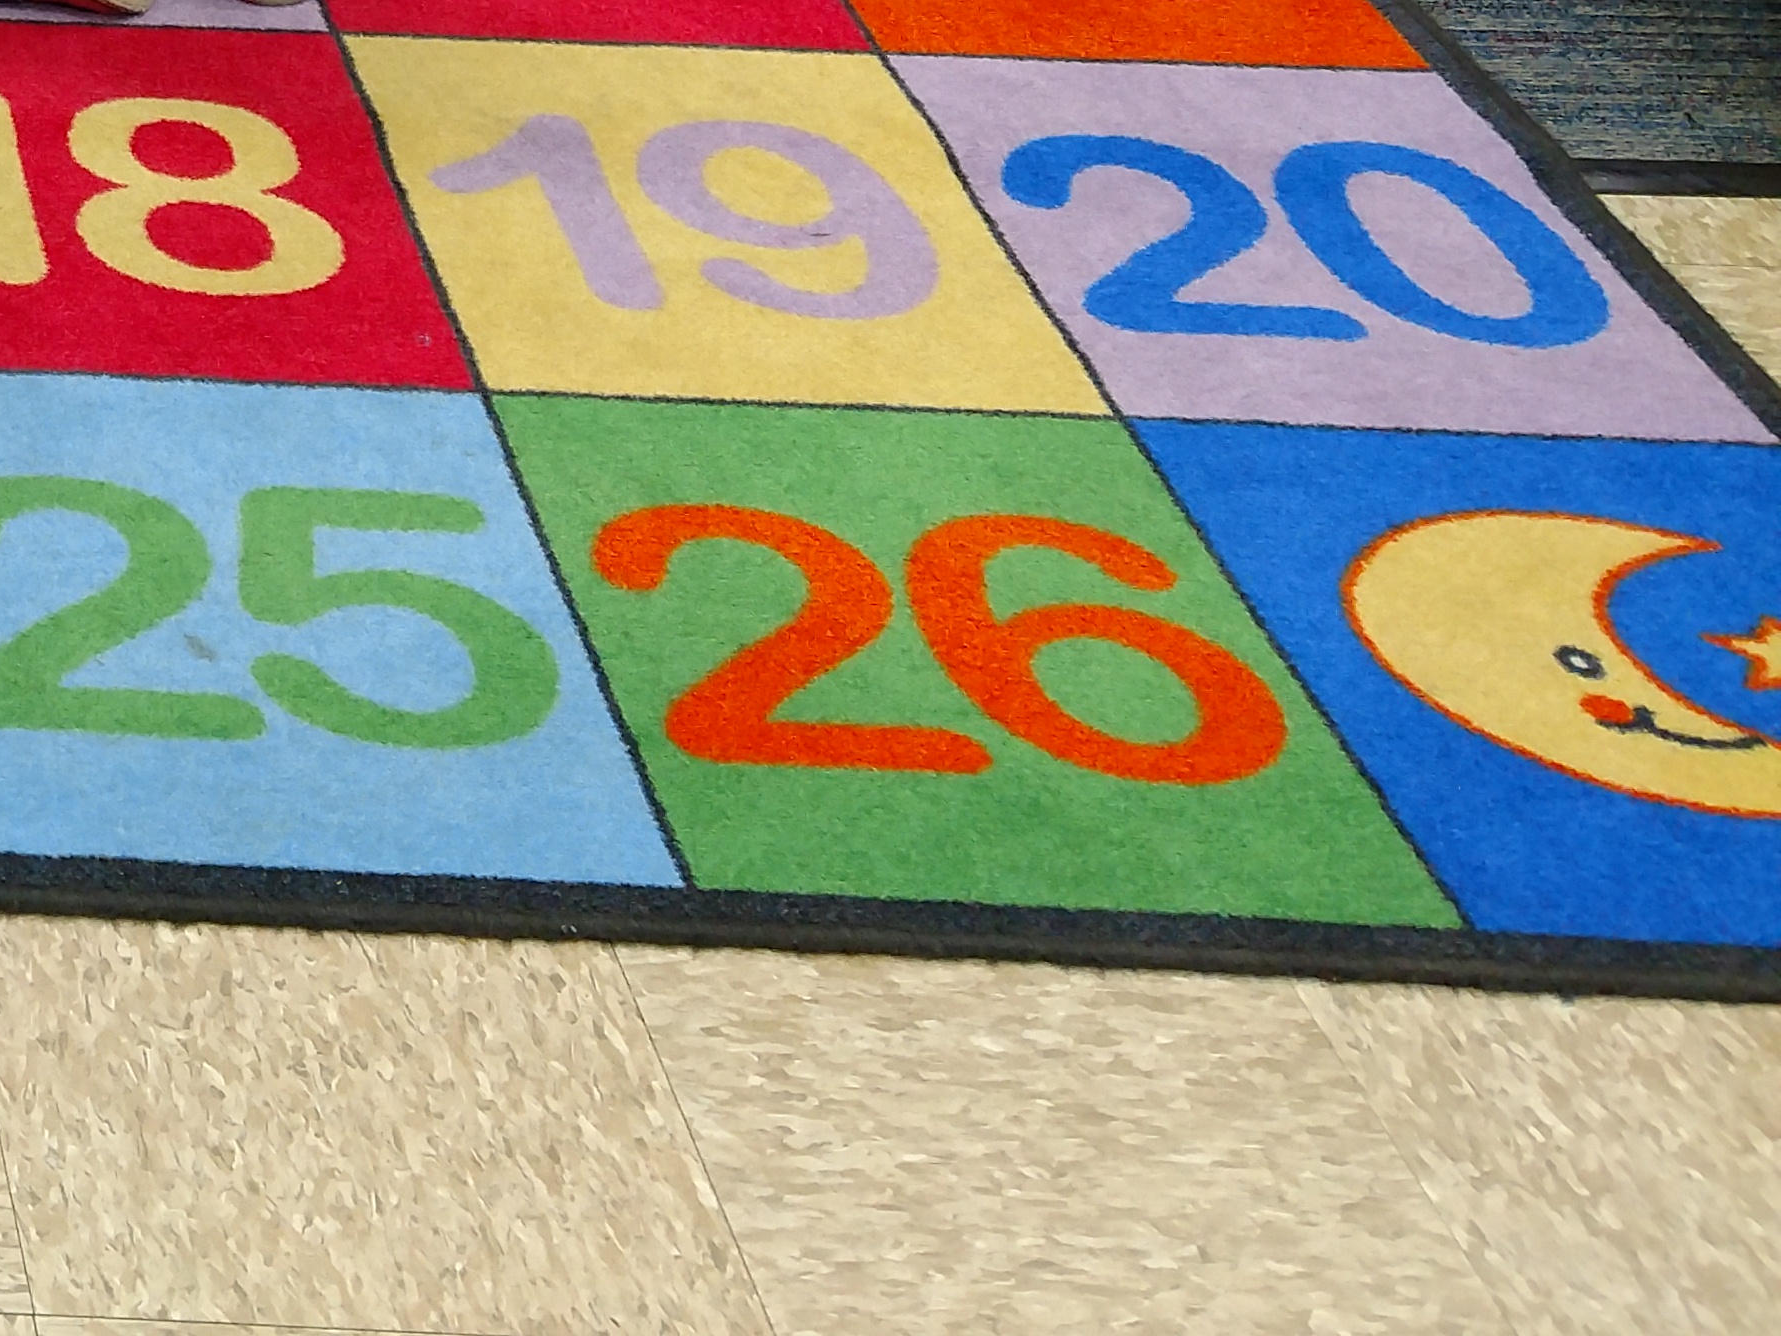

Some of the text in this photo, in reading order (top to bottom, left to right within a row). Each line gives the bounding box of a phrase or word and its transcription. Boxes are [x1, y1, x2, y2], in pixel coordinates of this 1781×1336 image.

[426, 112, 940, 320] 19
[999, 131, 1611, 348] 20
[590, 501, 1290, 788] 26
